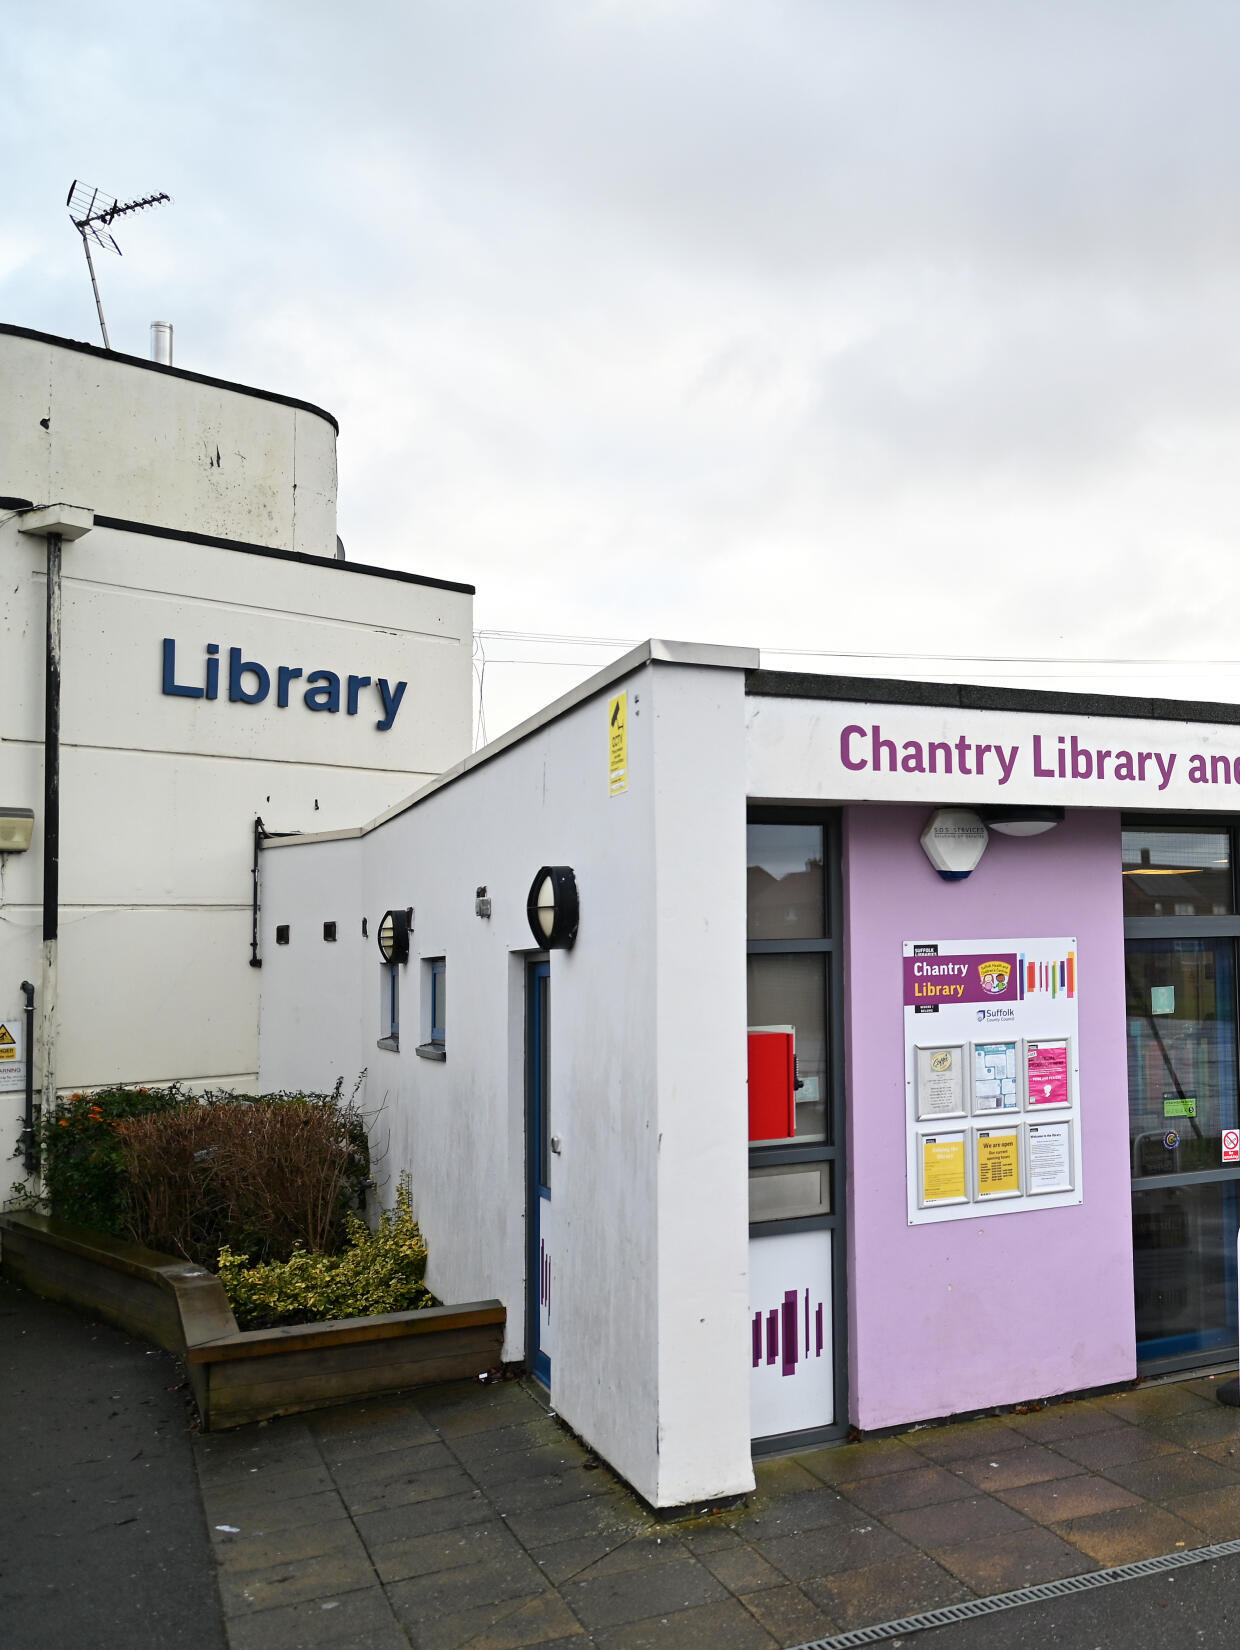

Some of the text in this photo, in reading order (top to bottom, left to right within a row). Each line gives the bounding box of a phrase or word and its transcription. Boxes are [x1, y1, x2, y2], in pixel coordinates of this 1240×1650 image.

[161, 637, 408, 731] Library
[839, 724, 1019, 786] Chantry
[1032, 734, 1177, 791] Library
[914, 962, 969, 977] Chantry
[914, 982, 965, 998] Library
[986, 1008, 1014, 1018] Suffolk
